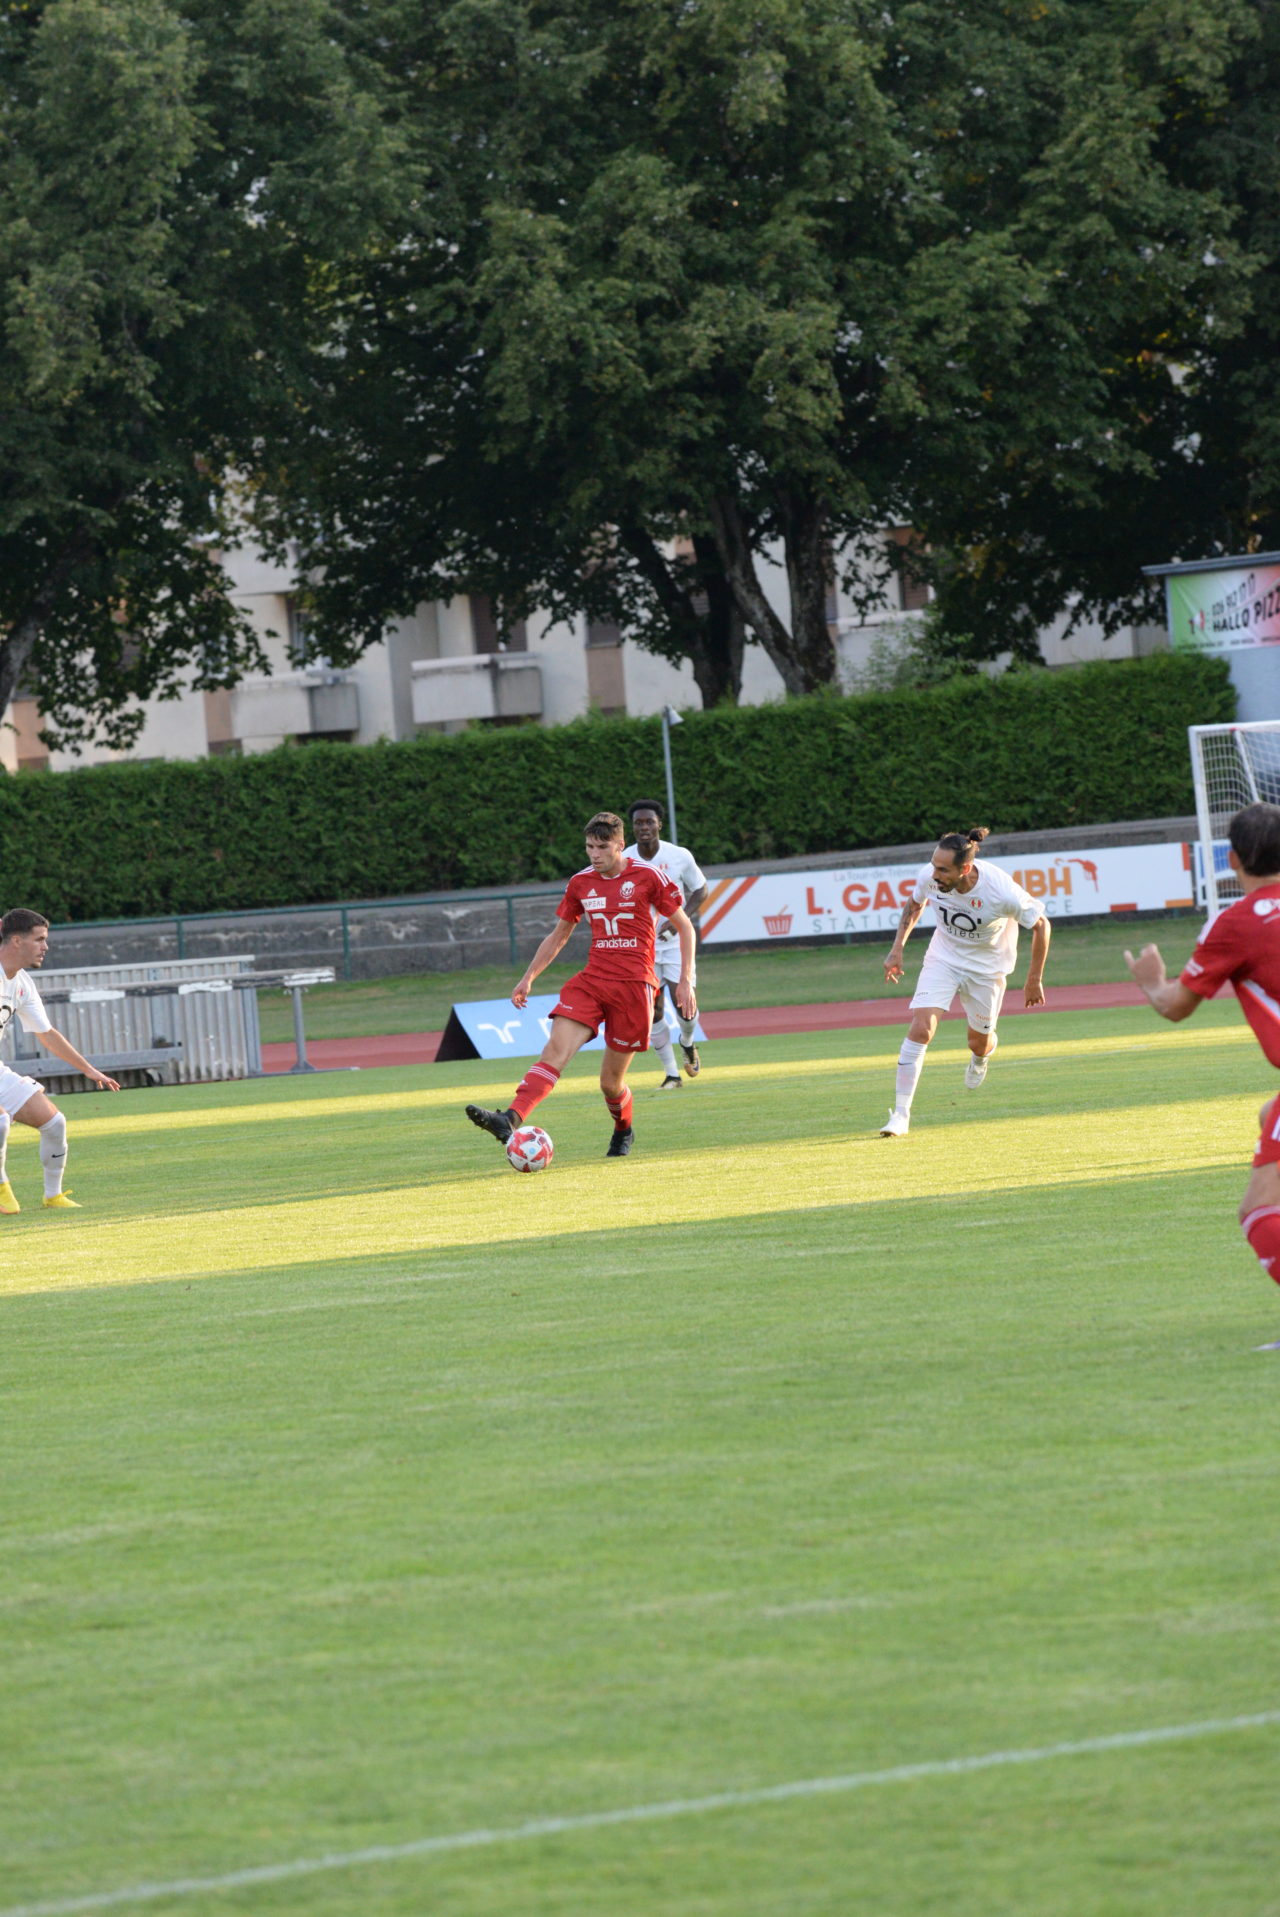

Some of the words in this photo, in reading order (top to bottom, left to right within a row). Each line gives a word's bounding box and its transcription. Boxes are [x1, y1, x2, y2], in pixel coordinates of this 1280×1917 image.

[1213, 607, 1250, 632] HALLO
[806, 886, 832, 915] L.
[842, 879, 919, 912] GAS
[812, 912, 922, 933] STATIO
